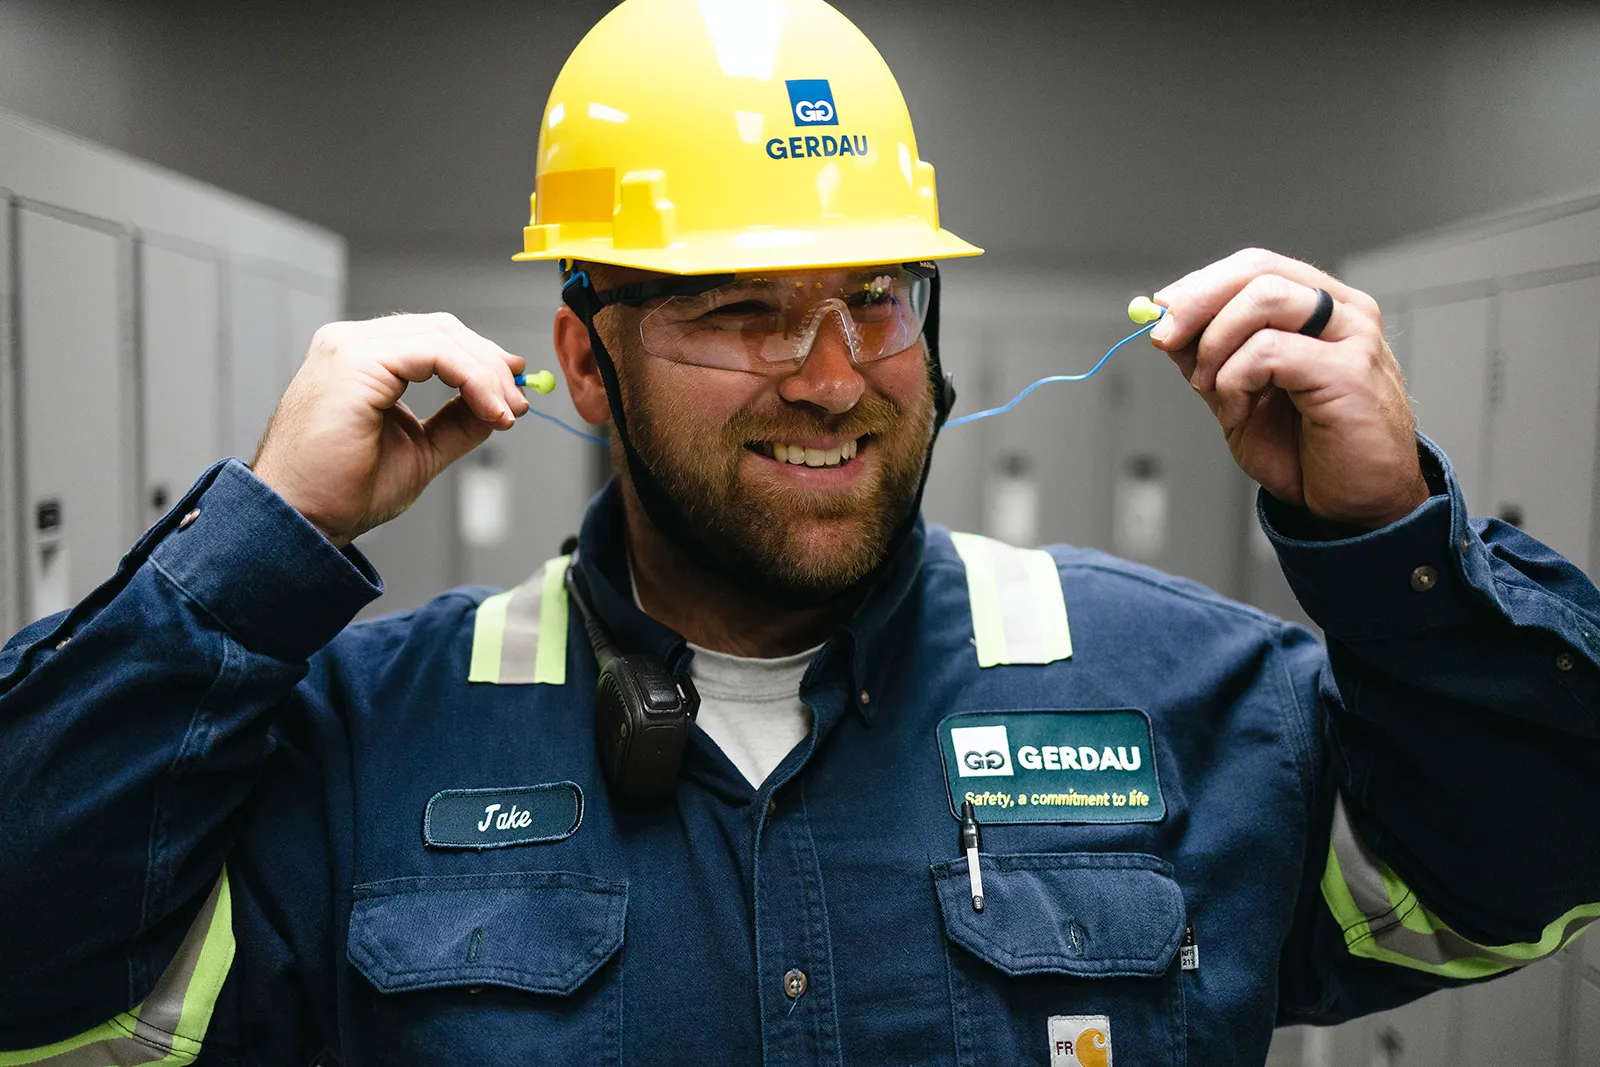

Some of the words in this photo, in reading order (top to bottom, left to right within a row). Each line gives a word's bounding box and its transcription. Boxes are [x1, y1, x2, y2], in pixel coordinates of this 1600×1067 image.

[766, 135, 868, 160] GERDAU
[1017, 745, 1141, 771] GERDAU
[965, 791, 1014, 808] Safety,
[1018, 793, 1027, 805] a
[1030, 788, 1110, 806] commitment
[1112, 792, 1126, 806] to
[1129, 789, 1150, 806] life
[478, 803, 532, 832] Jake
[1056, 1041, 1073, 1056] FR
